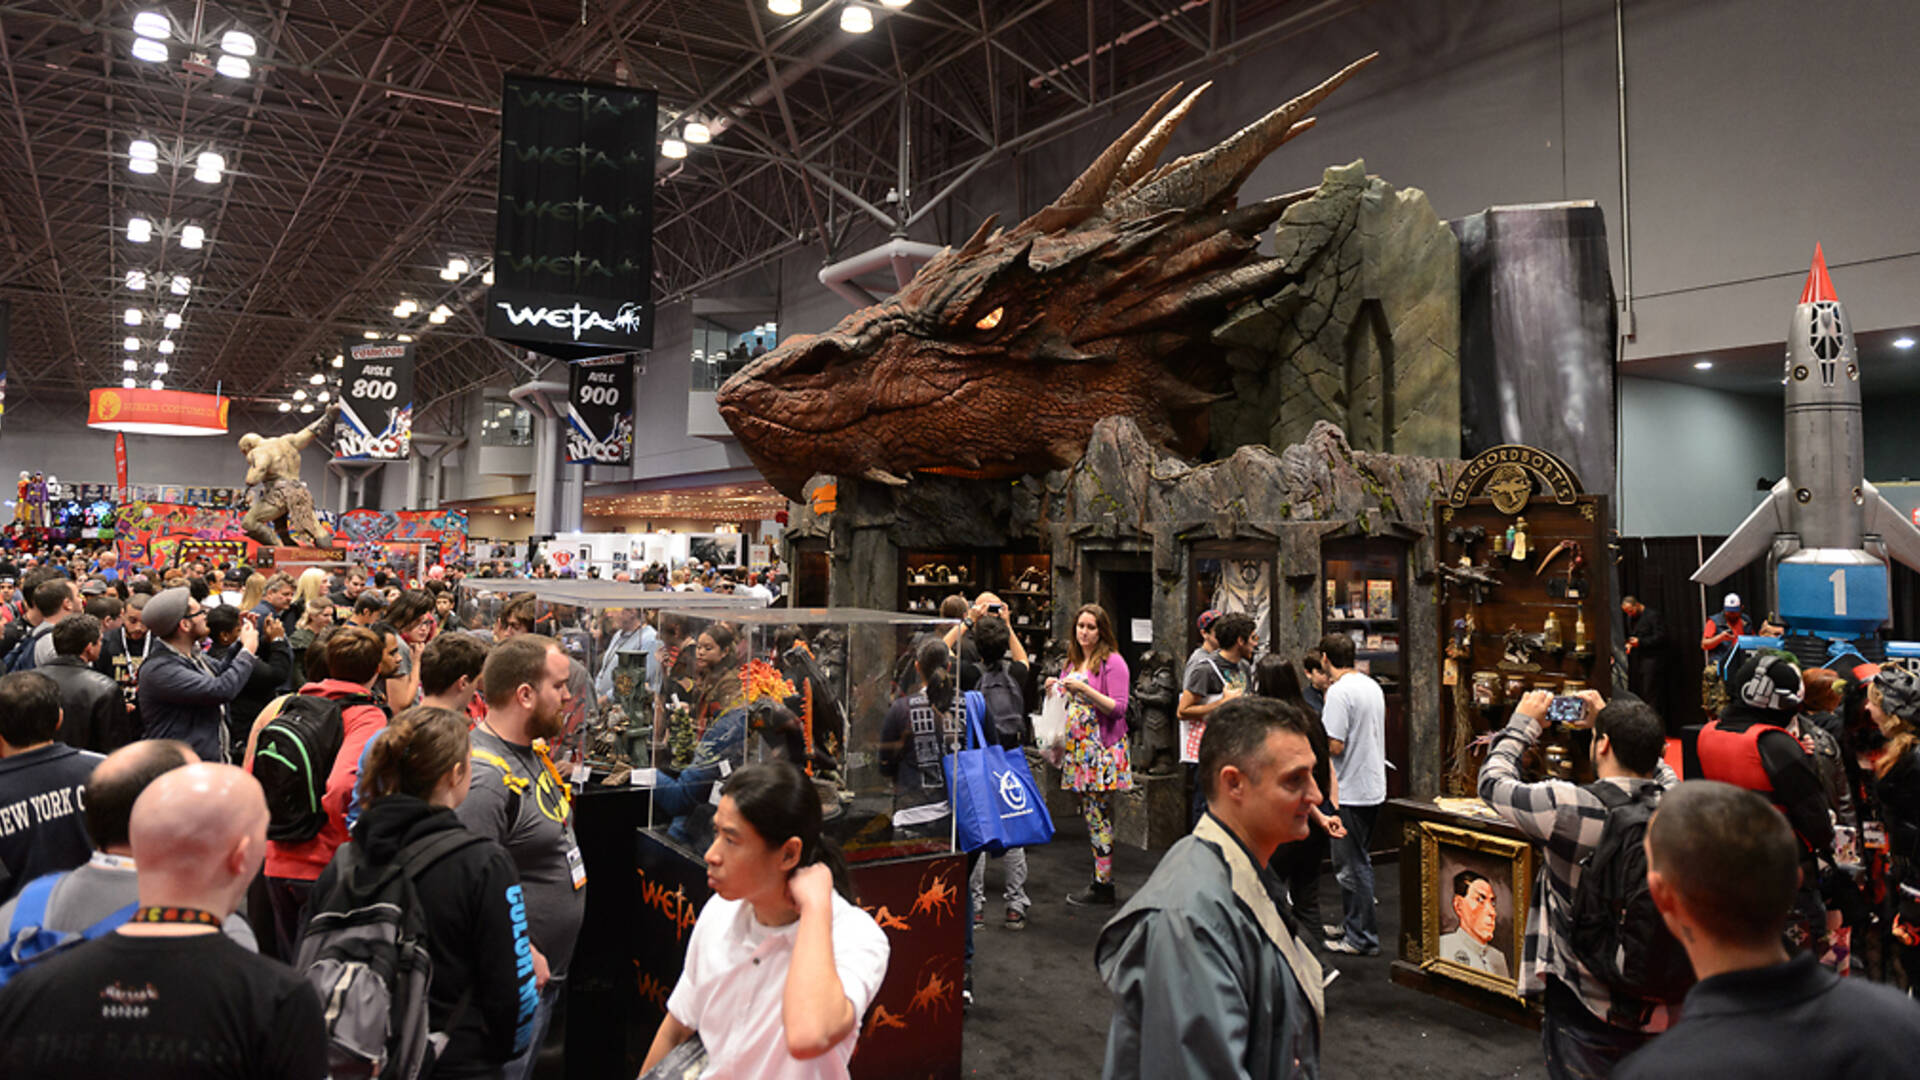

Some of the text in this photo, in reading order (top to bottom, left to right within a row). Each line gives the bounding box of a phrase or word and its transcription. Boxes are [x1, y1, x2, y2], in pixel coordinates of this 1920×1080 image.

[362, 364, 393, 377] AISLE
[587, 371, 616, 383] AISLE
[351, 378, 398, 400] 800
[580, 385, 619, 406] 900
[338, 434, 401, 458] NYCC
[567, 440, 620, 462] NYCC
[1828, 568, 1847, 616] 1
[30, 786, 74, 823] YORK
